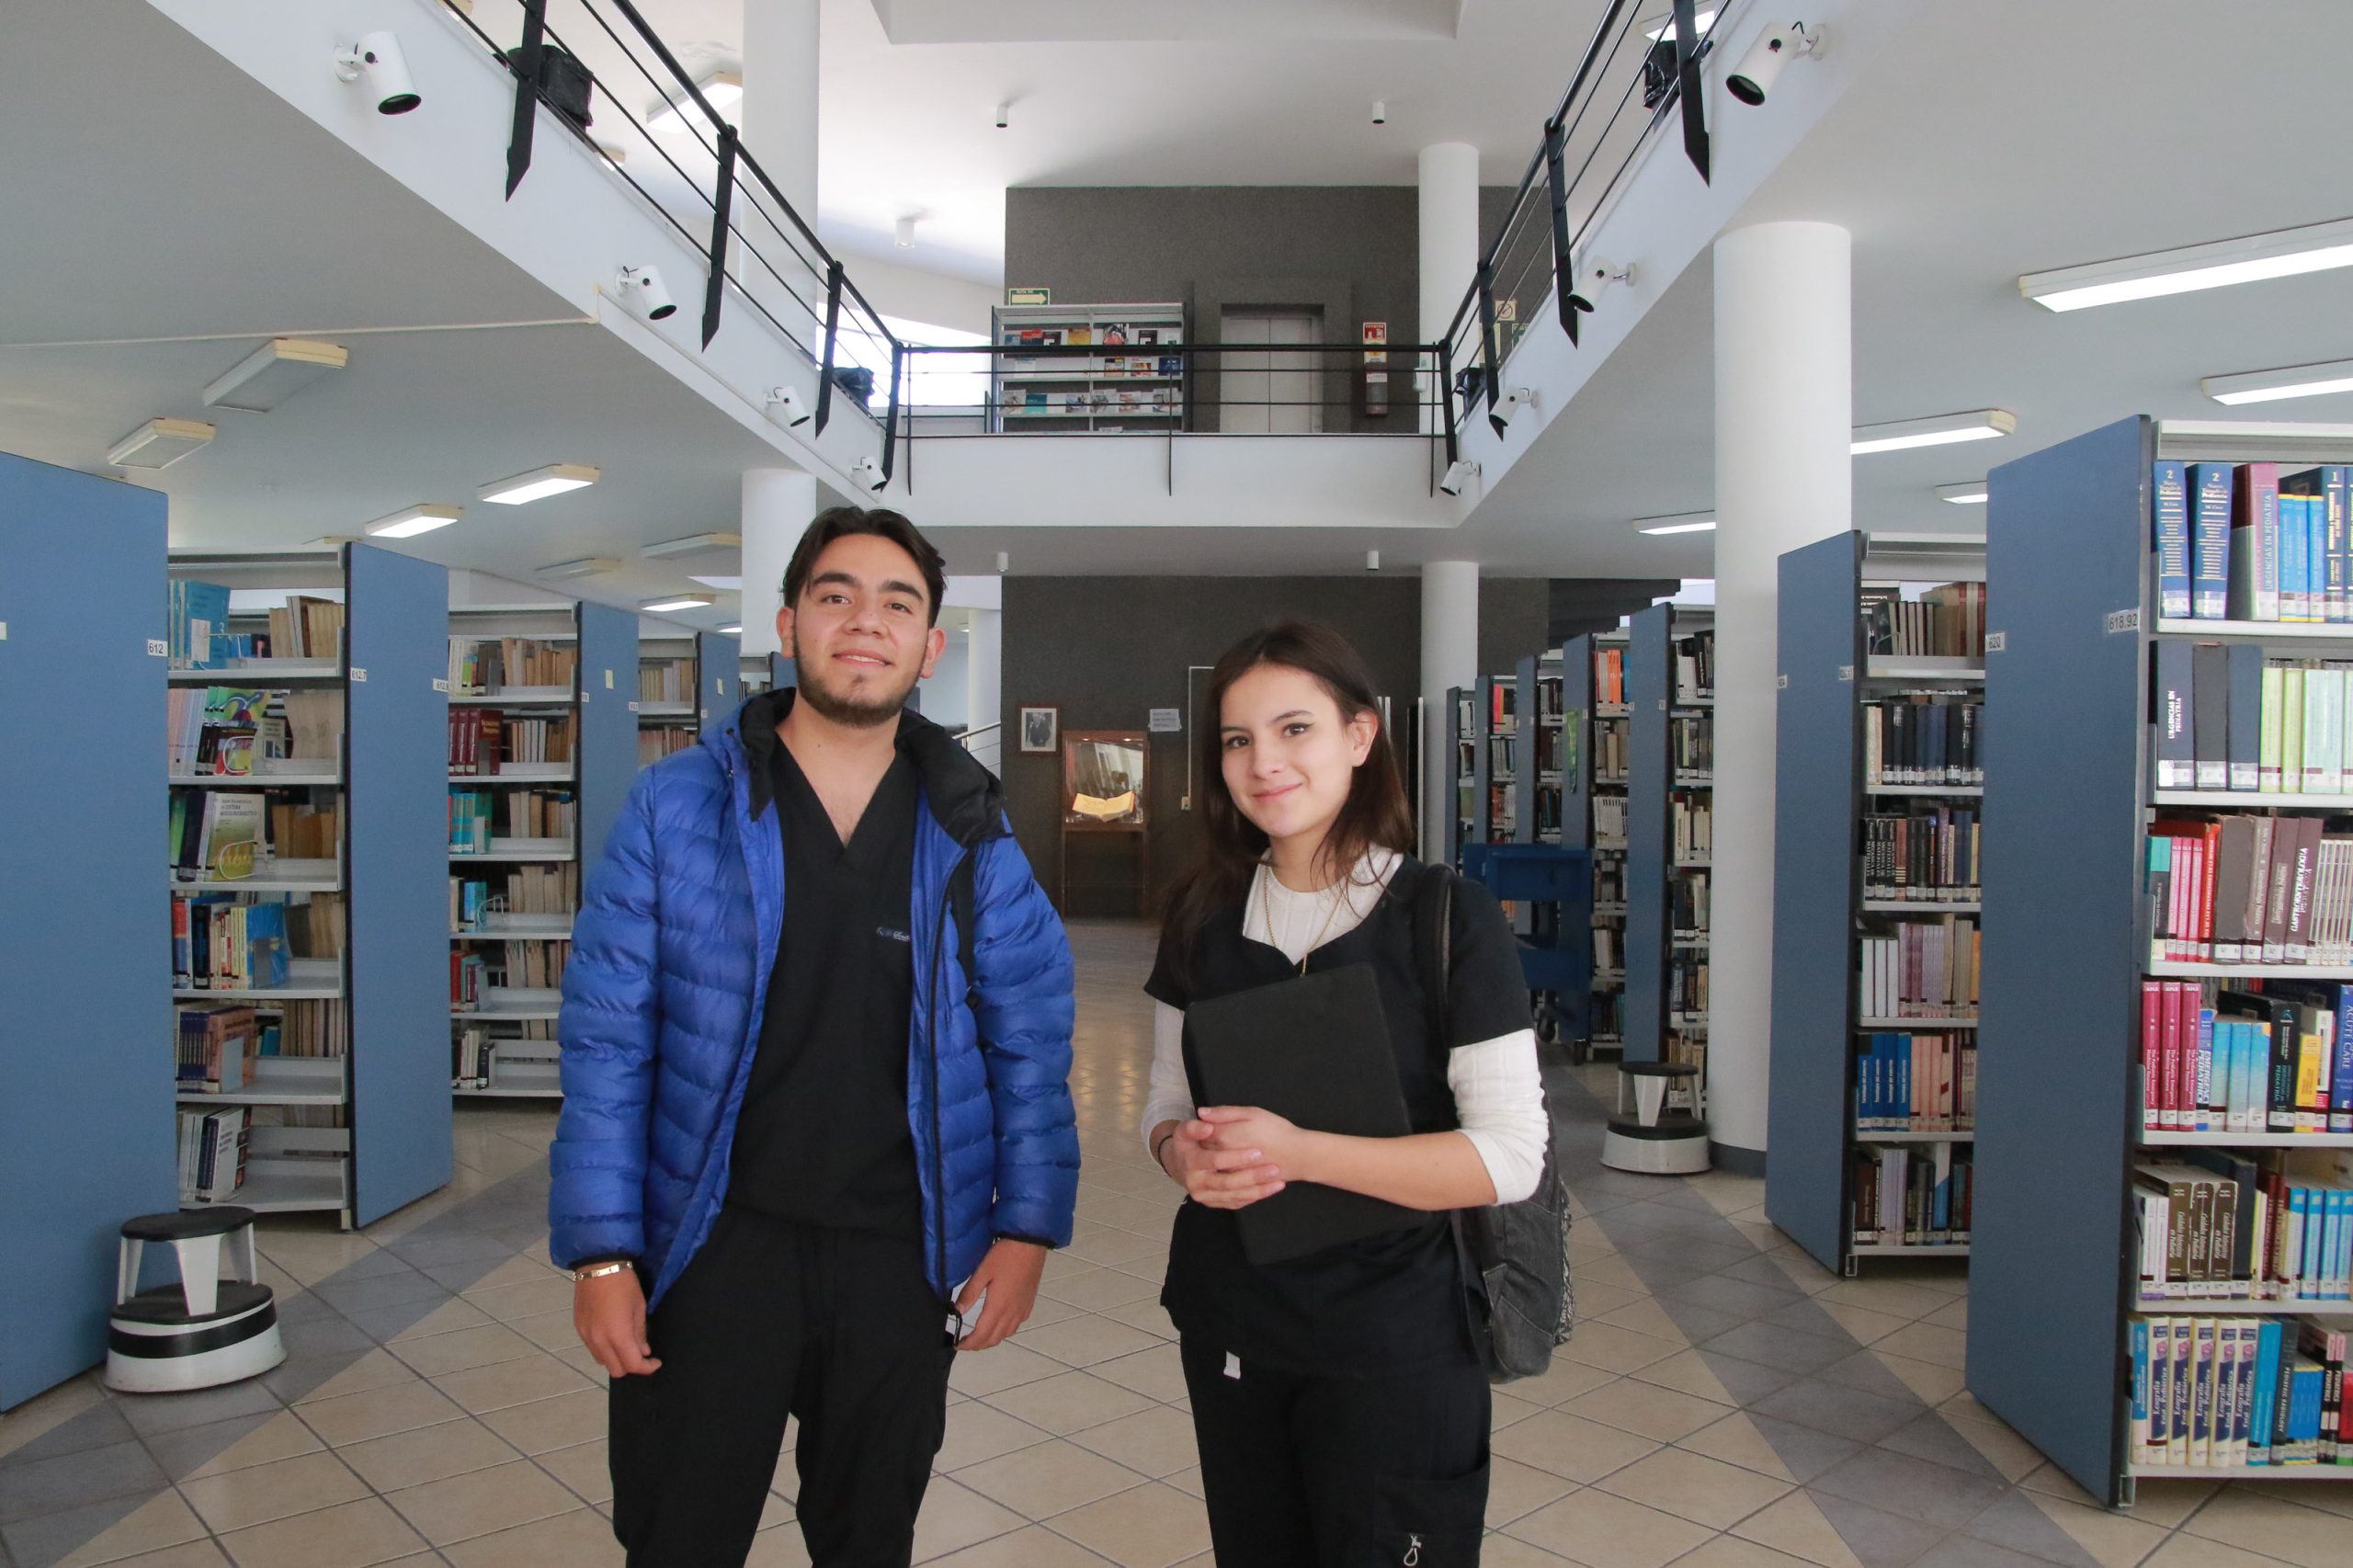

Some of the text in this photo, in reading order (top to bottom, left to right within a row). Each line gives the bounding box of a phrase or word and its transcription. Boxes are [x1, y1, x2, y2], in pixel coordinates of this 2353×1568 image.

[2166, 470, 2174, 479] 2
[2212, 472, 2220, 482] 2
[2264, 535, 2273, 545] EN
[2264, 547, 2273, 590] URGENCIAS
[2109, 613, 2137, 631] 618.92
[1989, 636, 2000, 648] 620
[149, 643, 164, 654] 612
[2168, 690, 2176, 699] EN
[2342, 1005, 2353, 1069] ACUTE CARE
[2279, 1367, 2290, 1432] PEDIATRIC RADIOLOGY
